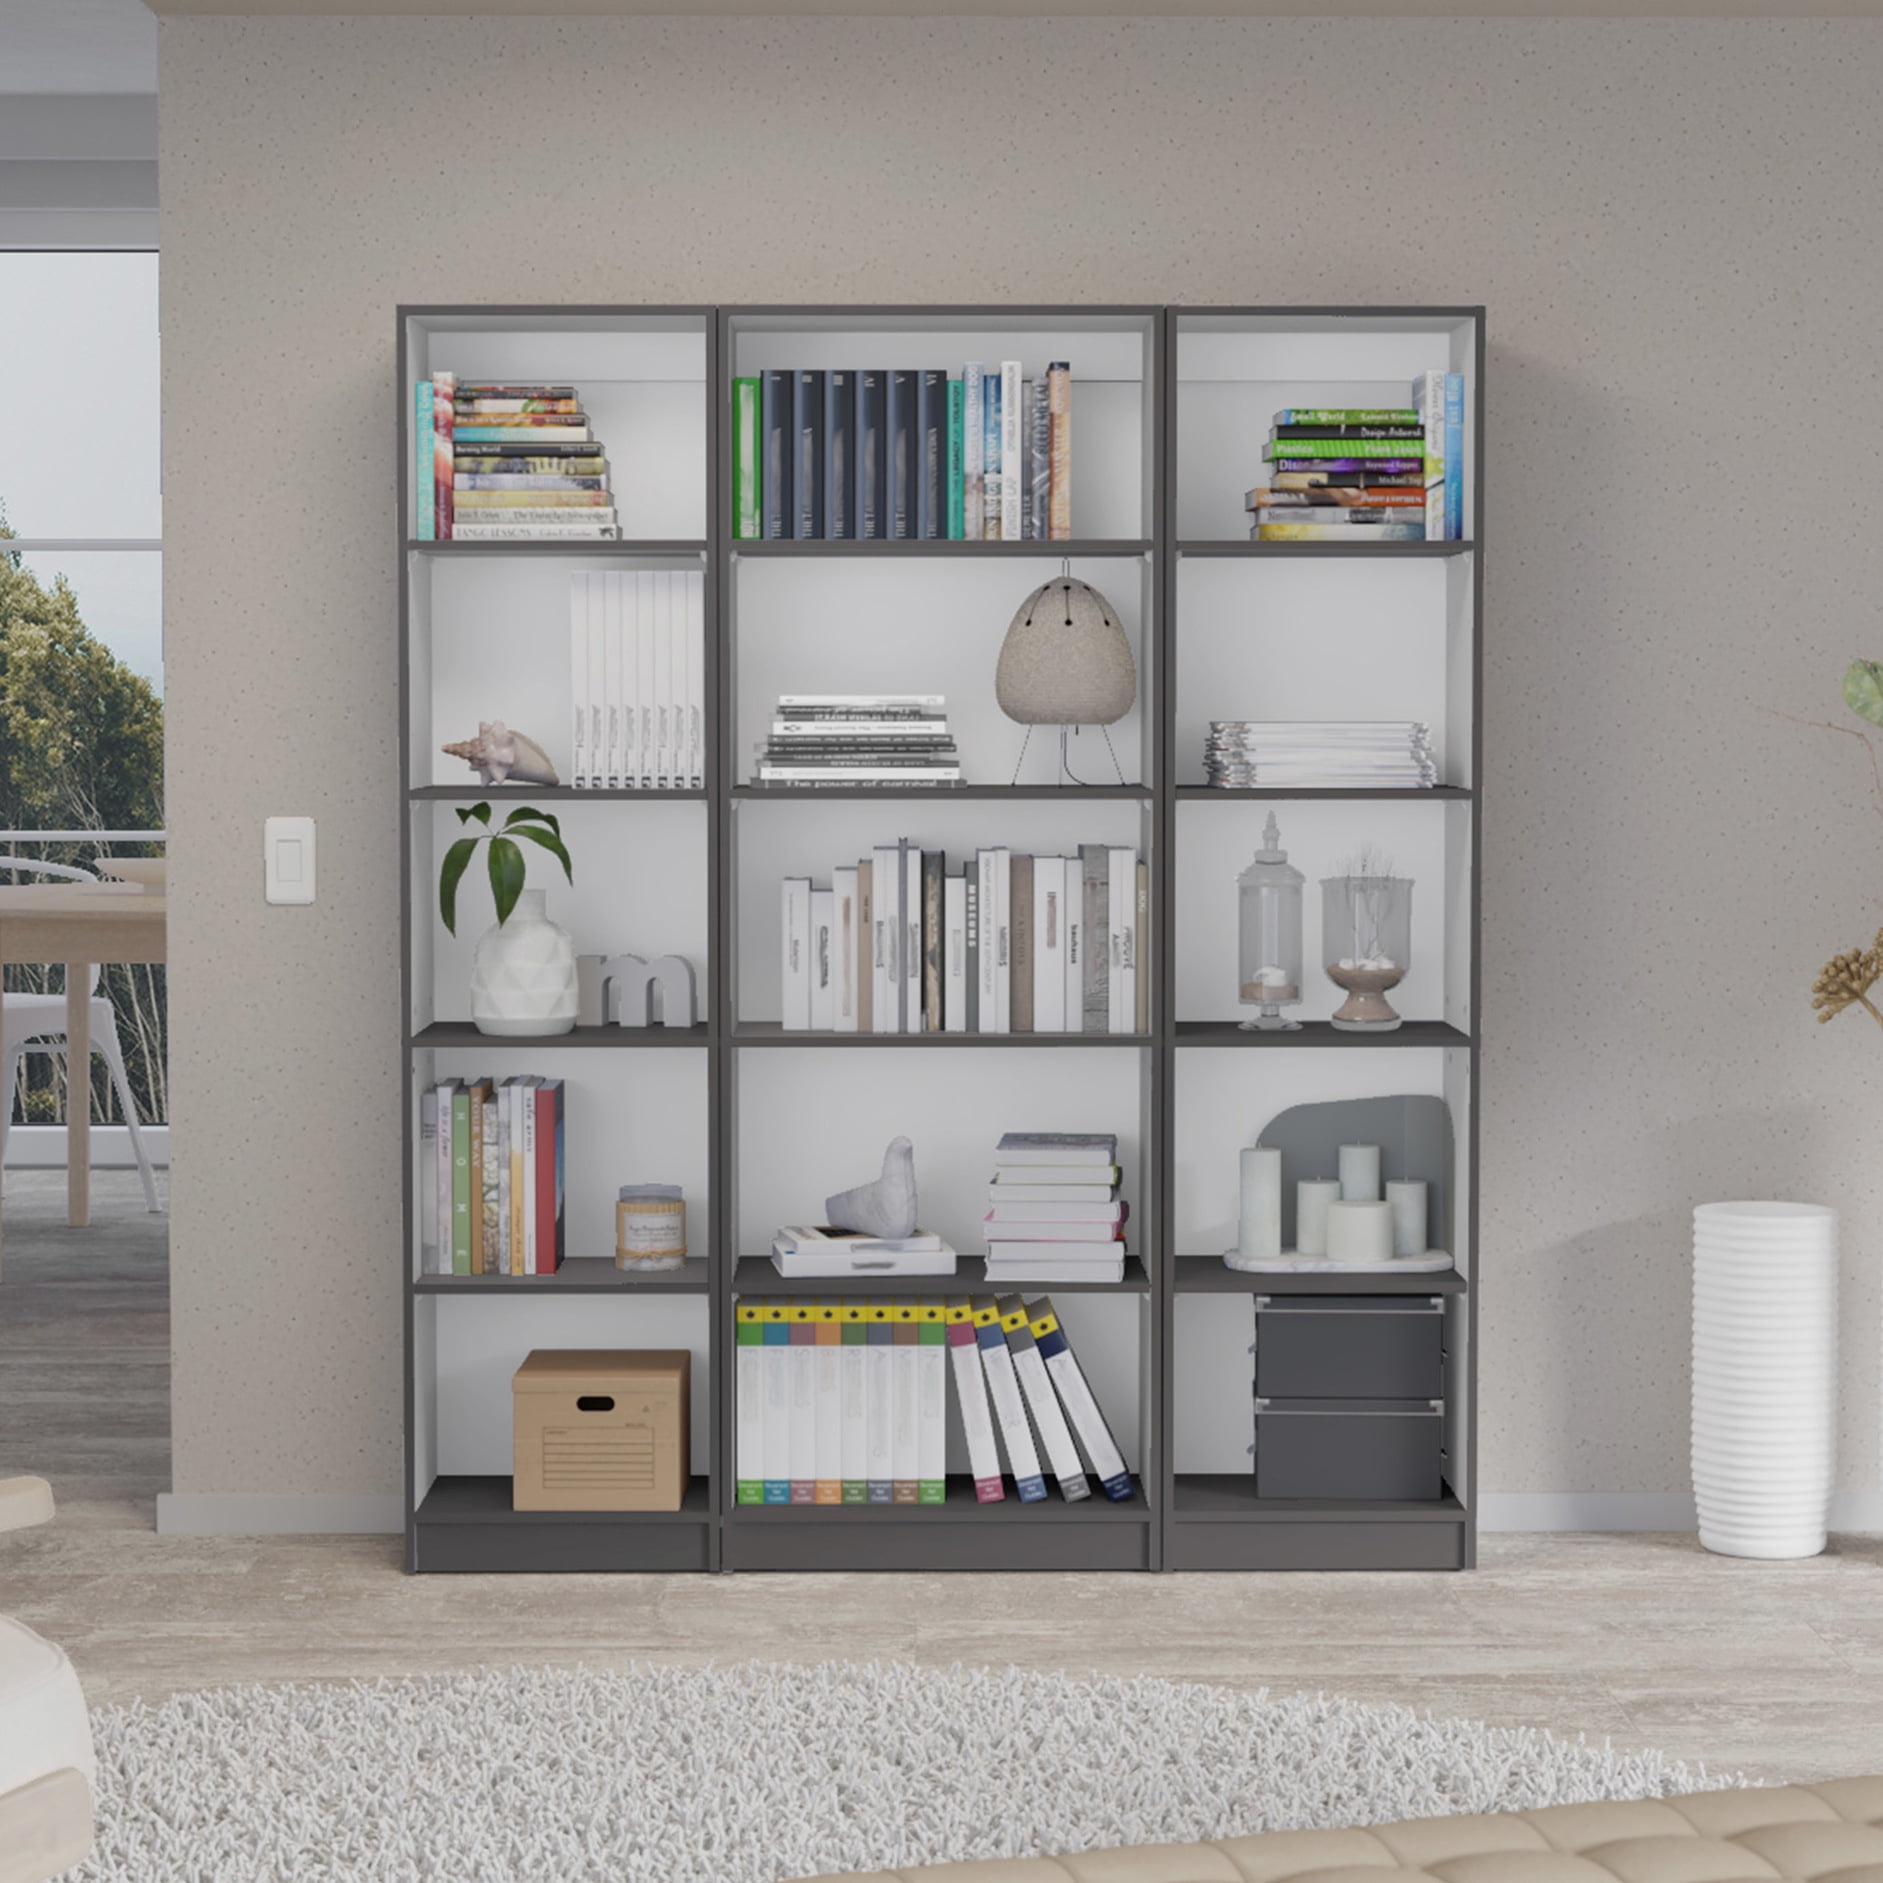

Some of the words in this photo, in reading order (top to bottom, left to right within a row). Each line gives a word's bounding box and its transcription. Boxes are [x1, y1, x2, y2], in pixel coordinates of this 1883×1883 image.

[953, 384, 961, 424] TOLSTOY
[1318, 411, 1345, 422] World
[953, 440, 961, 476] LEGACY
[967, 884, 977, 947] MUSEUMS
[1070, 924, 1078, 965] bauhaus
[471, 1096, 480, 1133] YOUR
